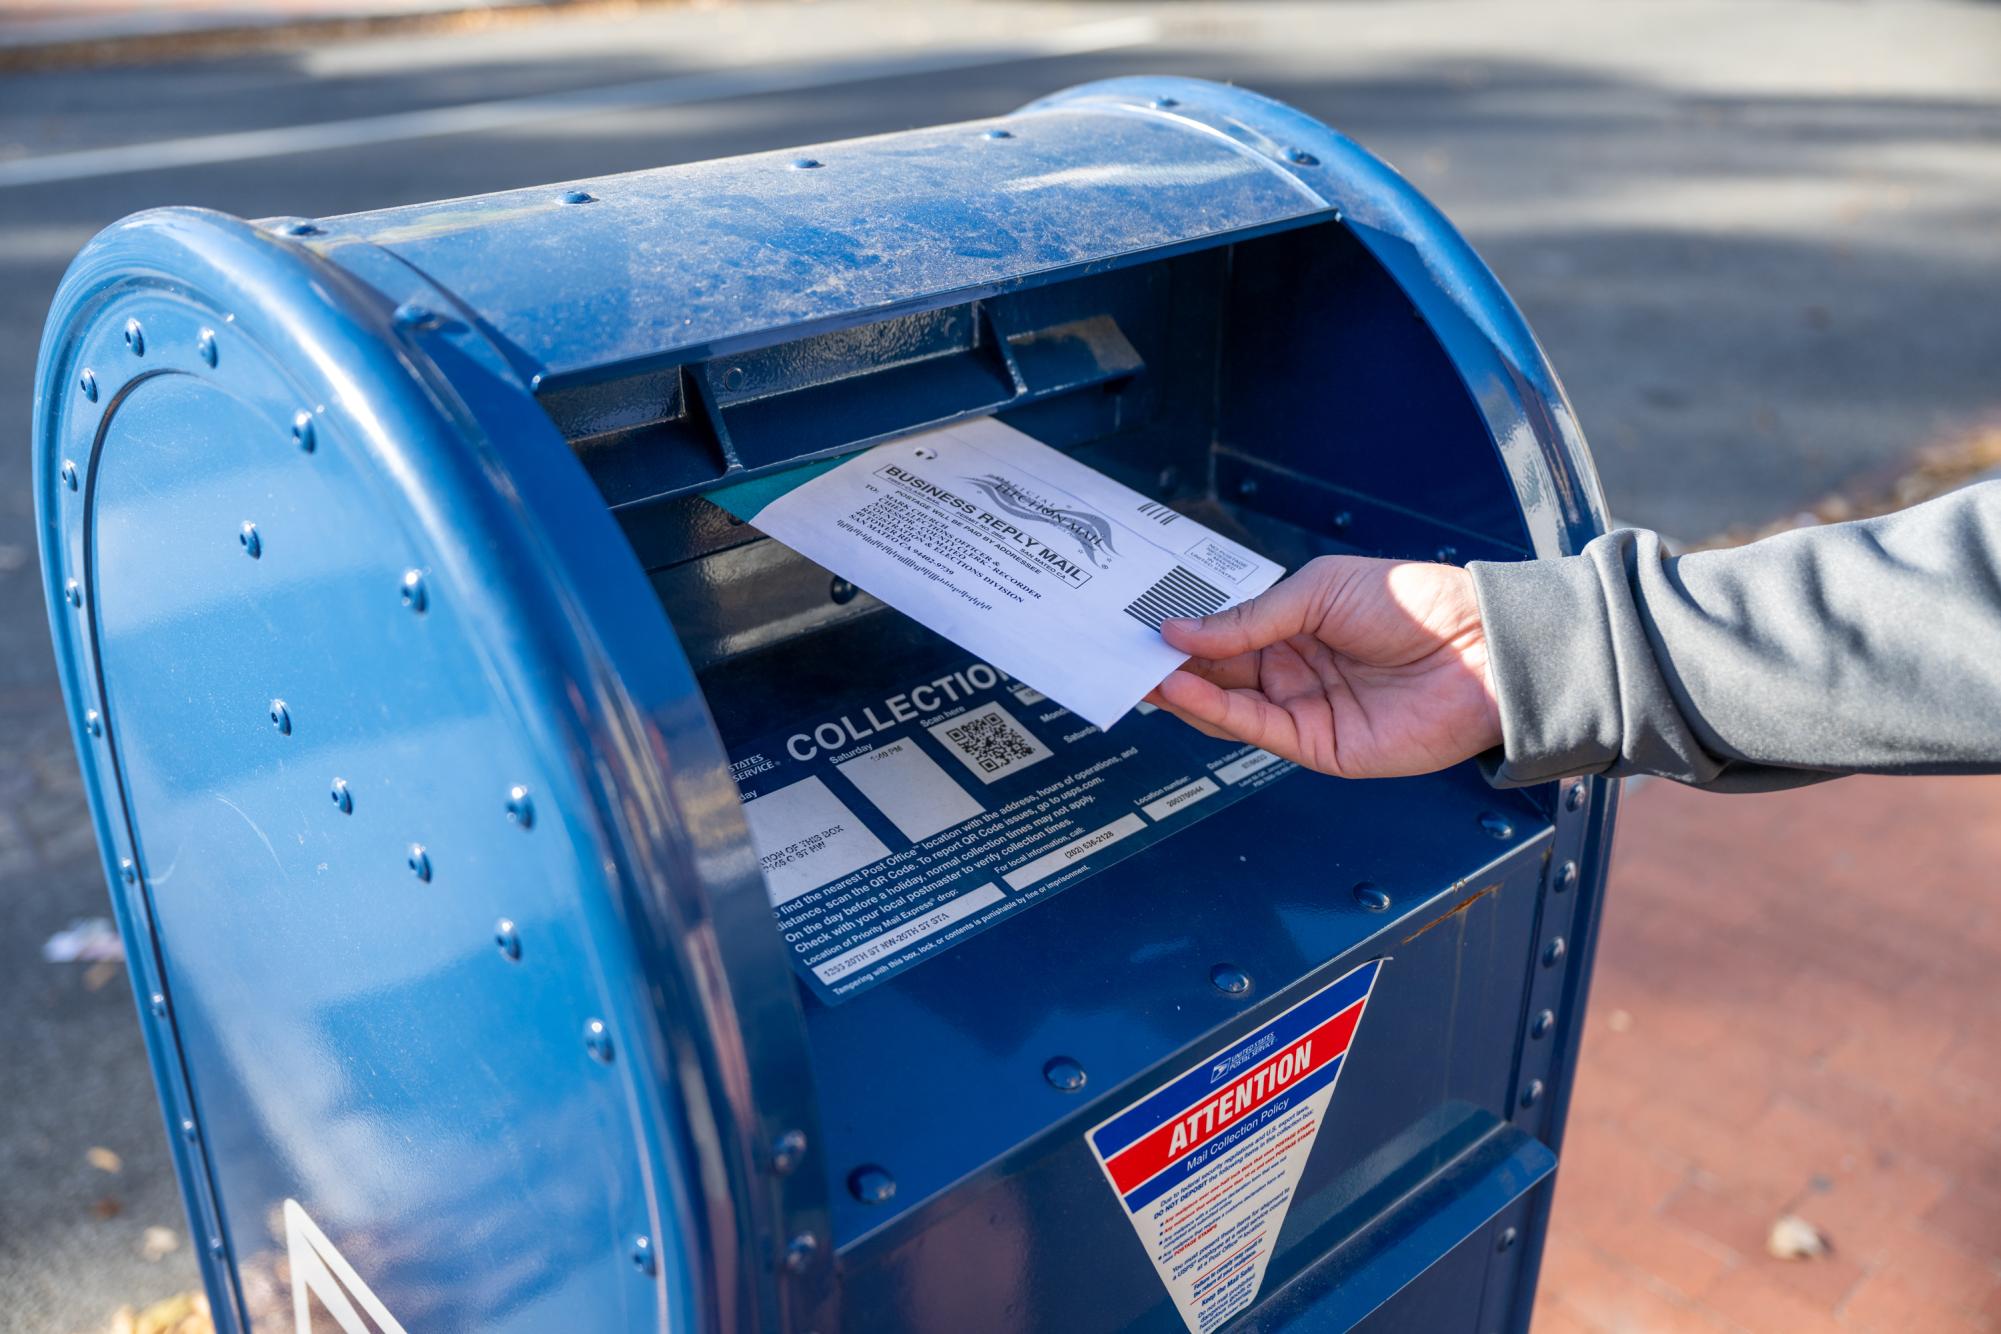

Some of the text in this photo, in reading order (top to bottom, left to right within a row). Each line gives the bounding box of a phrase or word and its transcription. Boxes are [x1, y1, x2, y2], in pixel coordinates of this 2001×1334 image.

[848, 515, 867, 524] SAN
[867, 525, 899, 542] MATEO
[898, 541, 913, 550] CA
[864, 484, 948, 528] TO: MARK CHURCH
[865, 517, 897, 533] TOWER
[896, 533, 912, 542] RD
[866, 505, 902, 523] COUNTY
[915, 531, 933, 540] SAN
[933, 541, 966, 558] MATEO
[878, 498, 906, 512] CHIEF
[905, 512, 953, 538] ELECTIONS
[953, 538, 993, 560] OFFICER
[885, 467, 978, 513] BUSINESS
[977, 513, 1039, 548] REPLY
[1037, 549, 1088, 580] MAIL
[895, 490, 931, 509] POSTAGE
[930, 509, 951, 519] WILL
[963, 526, 982, 536] PAID
[994, 544, 1042, 573] ADDRESSEE
[994, 484, 1065, 523] ELECTION
[1067, 521, 1103, 546] MAIL
[861, 508, 924, 542] REGISTRATION
[933, 547, 983, 576] ELECTIONS
[982, 577, 1024, 602] DIVISION
[872, 501, 1042, 598] ASSESSOR COUNTY CLERK RECORDER
[1034, 558, 1056, 571] MATEO
[919, 705, 965, 727] Scan here
[728, 754, 764, 771] STATES
[732, 761, 774, 781] SERVICE
[829, 743, 873, 764] Saturday
[780, 900, 803, 913] find
[802, 891, 822, 903] the
[822, 873, 862, 895] nearest
[862, 862, 886, 876] Post
[922, 828, 961, 848] location
[961, 818, 983, 831] with
[982, 810, 999, 821] the
[999, 793, 1038, 814] address,
[1037, 781, 1064, 796] hours
[1063, 776, 1073, 784] of
[1073, 754, 1122, 780] operations,
[1121, 747, 1137, 757] and
[785, 844, 799, 853] OF
[799, 834, 822, 847] THIS
[822, 825, 843, 837] BOX
[826, 894, 851, 908] scan
[851, 884, 870, 895] the
[870, 876, 888, 887] QR
[887, 861, 918, 879] Code.
[918, 856, 931, 865] To
[932, 842, 962, 859] report
[960, 834, 978, 845] QR
[978, 821, 1004, 836] Code
[1003, 806, 1037, 825] issues,
[1037, 802, 1051, 811] go
[1060, 775, 1105, 800] usps.com.
[994, 826, 1085, 873] For local information, call:
[1064, 846, 1084, 858] (202)
[785, 793, 1096, 941] On the day before a holiday, normal collection times may not apply.
[794, 817, 1073, 952] Check with your local postmaster to verify collection times.
[804, 943, 842, 964] Location
[851, 924, 883, 942] Priority
[882, 915, 901, 927] Mail
[936, 888, 959, 902] drop:
[833, 973, 873, 995] Tampering
[871, 965, 889, 975] with
[887, 957, 903, 967] this
[902, 949, 920, 961] box,
[918, 942, 936, 953] lock,
[936, 937, 946, 945] or
[943, 922, 974, 940] contents
[972, 918, 982, 926] is
[980, 901, 1018, 922] punishable
[1025, 890, 1039, 899] fine
[1045, 863, 1089, 889] imprisonment.
[1232, 1031, 1272, 1060] UNITED STATES
[1168, 1039, 1310, 1157] ATTENTION
[1161, 1196, 1171, 1206] Due
[1181, 1177, 1198, 1192] federal
[1202, 1162, 1221, 1179] security
[1225, 1142, 1252, 1164] regulations
[1256, 1133, 1264, 1143] and
[1279, 1113, 1294, 1127] export
[1188, 1097, 1287, 1170] Mail Collection Policy
[1155, 1180, 1205, 1218] DO NOT DEPOSIT
